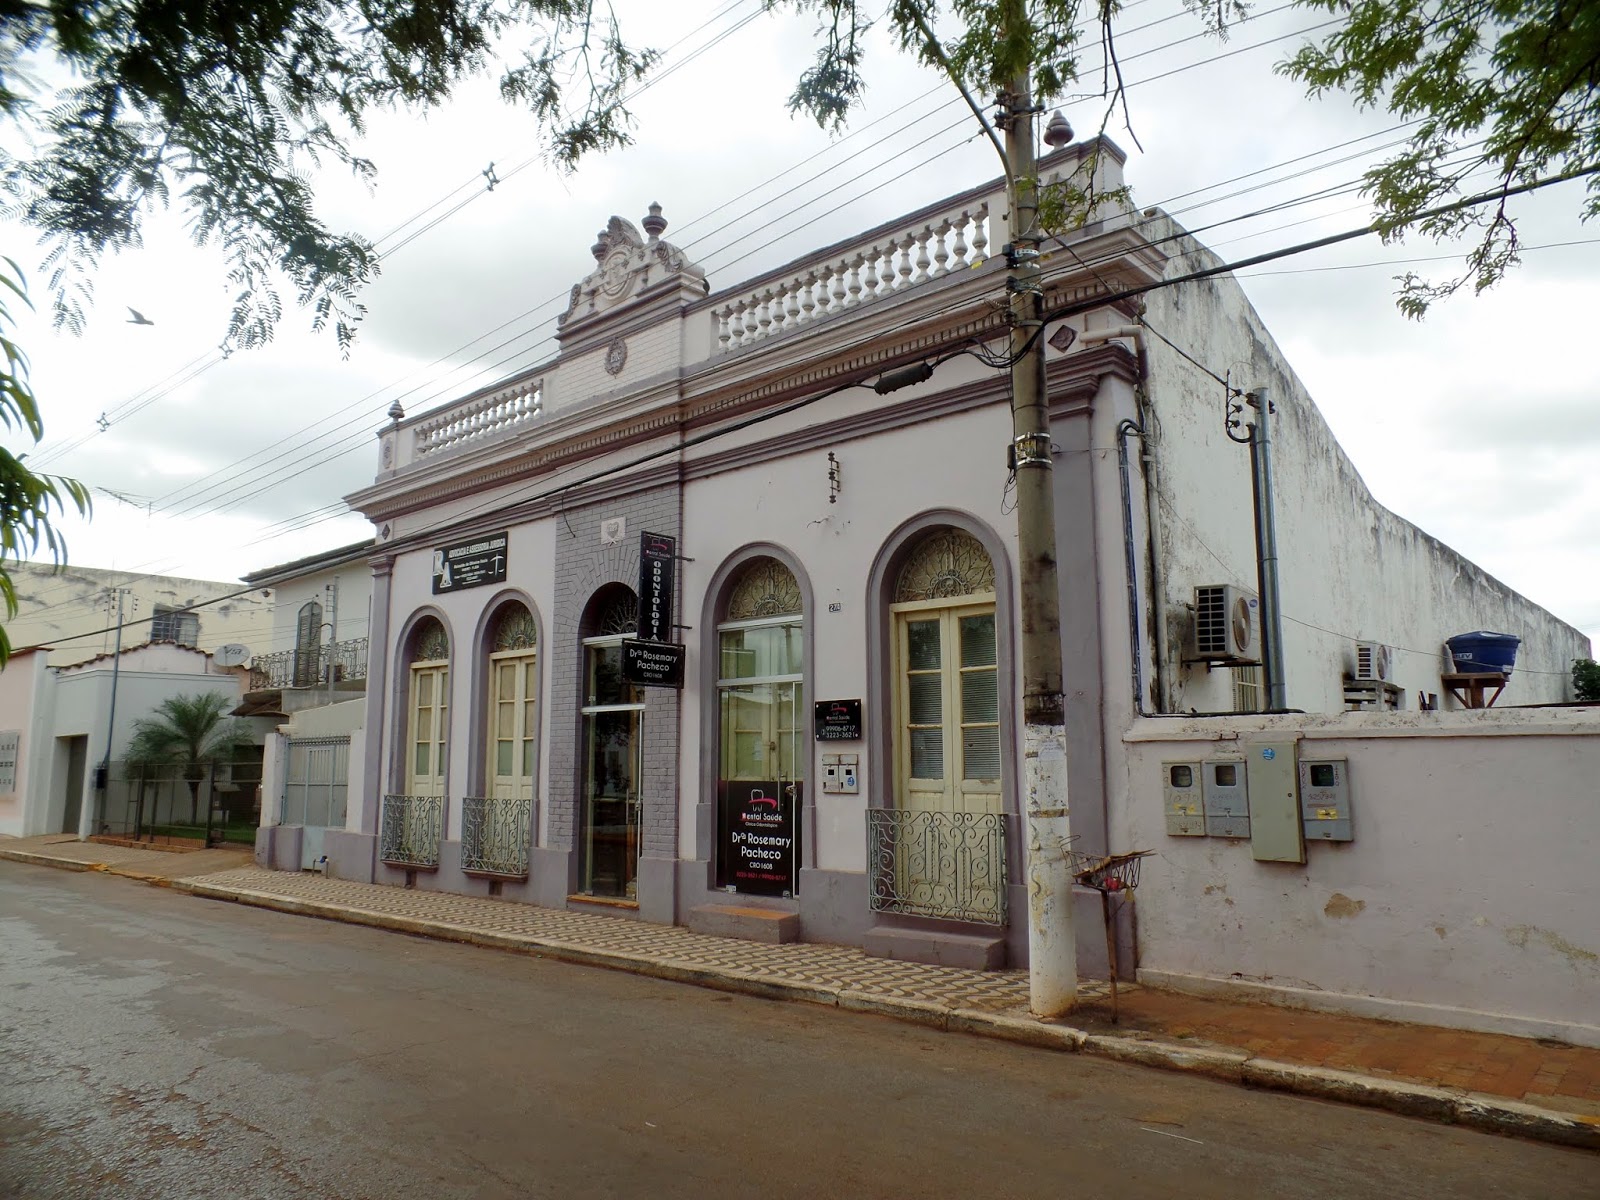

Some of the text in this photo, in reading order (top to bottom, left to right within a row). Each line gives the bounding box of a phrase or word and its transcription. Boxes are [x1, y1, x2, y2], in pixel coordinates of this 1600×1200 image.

[449, 547, 466, 558] ADVOCACIA
[470, 542, 489, 554] ASSESSORIA
[433, 551, 452, 588] R A
[651, 560, 662, 641] ODONTOLOGIA
[643, 650, 677, 663] Rosemary
[637, 659, 670, 672] Pacheco
[763, 812, 783, 822] Saúde
[748, 833, 791, 848] Rosemary
[741, 847, 781, 860] Pacheco
